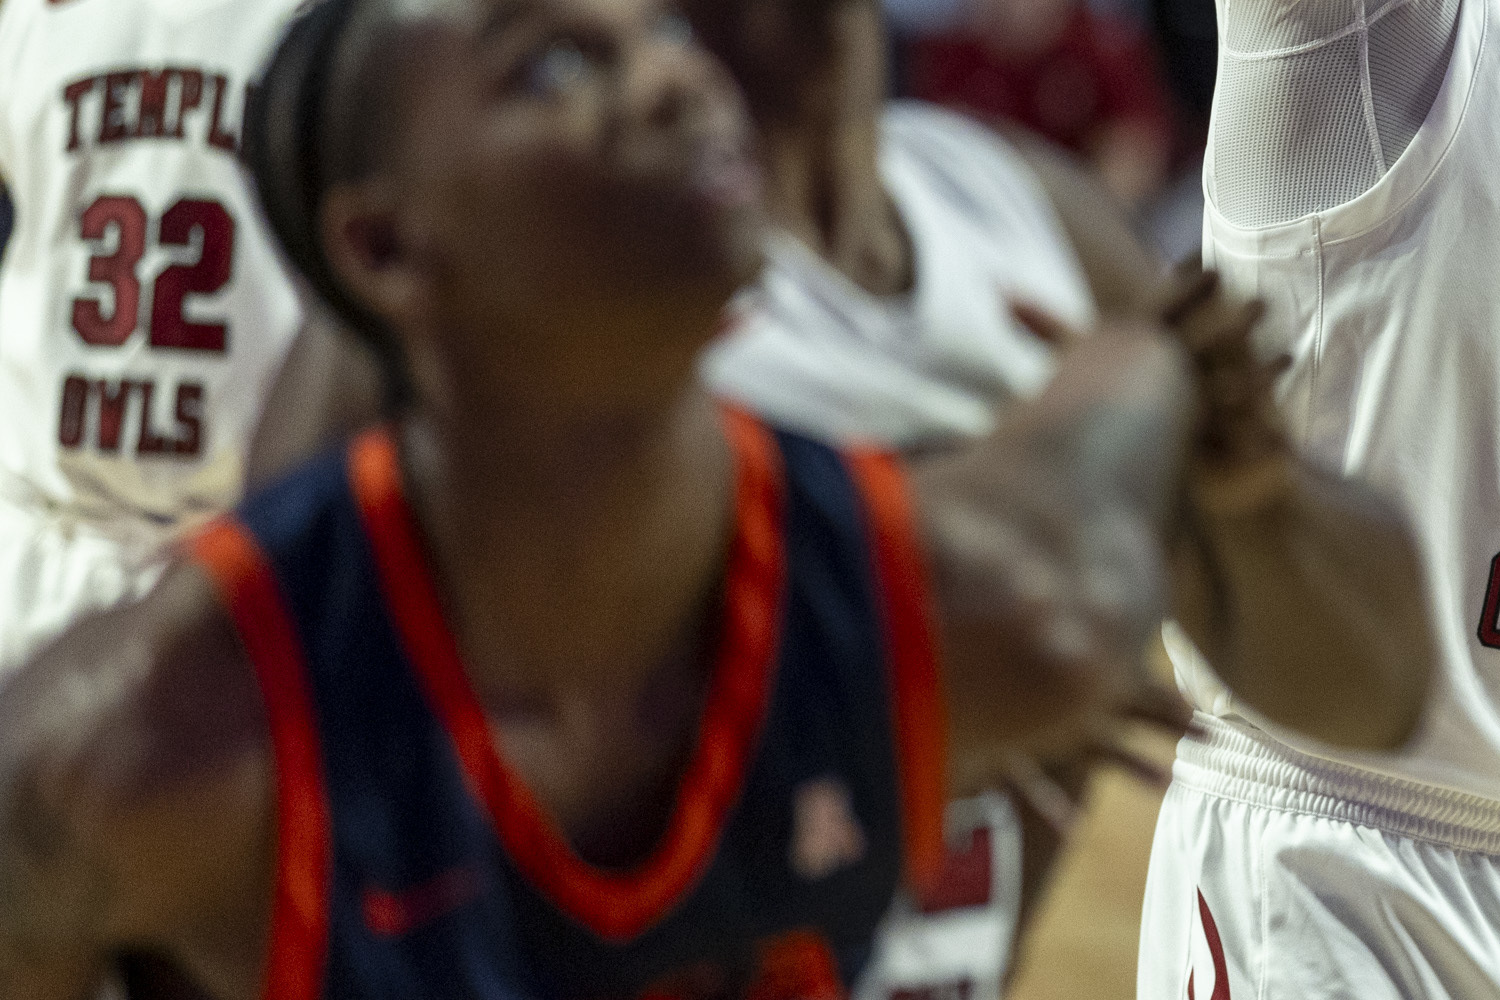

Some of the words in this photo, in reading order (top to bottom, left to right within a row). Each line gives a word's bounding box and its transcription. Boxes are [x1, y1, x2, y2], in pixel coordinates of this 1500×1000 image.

[63, 67, 258, 152] TEMPL
[71, 195, 236, 354] 32
[58, 373, 206, 458] OWLS
